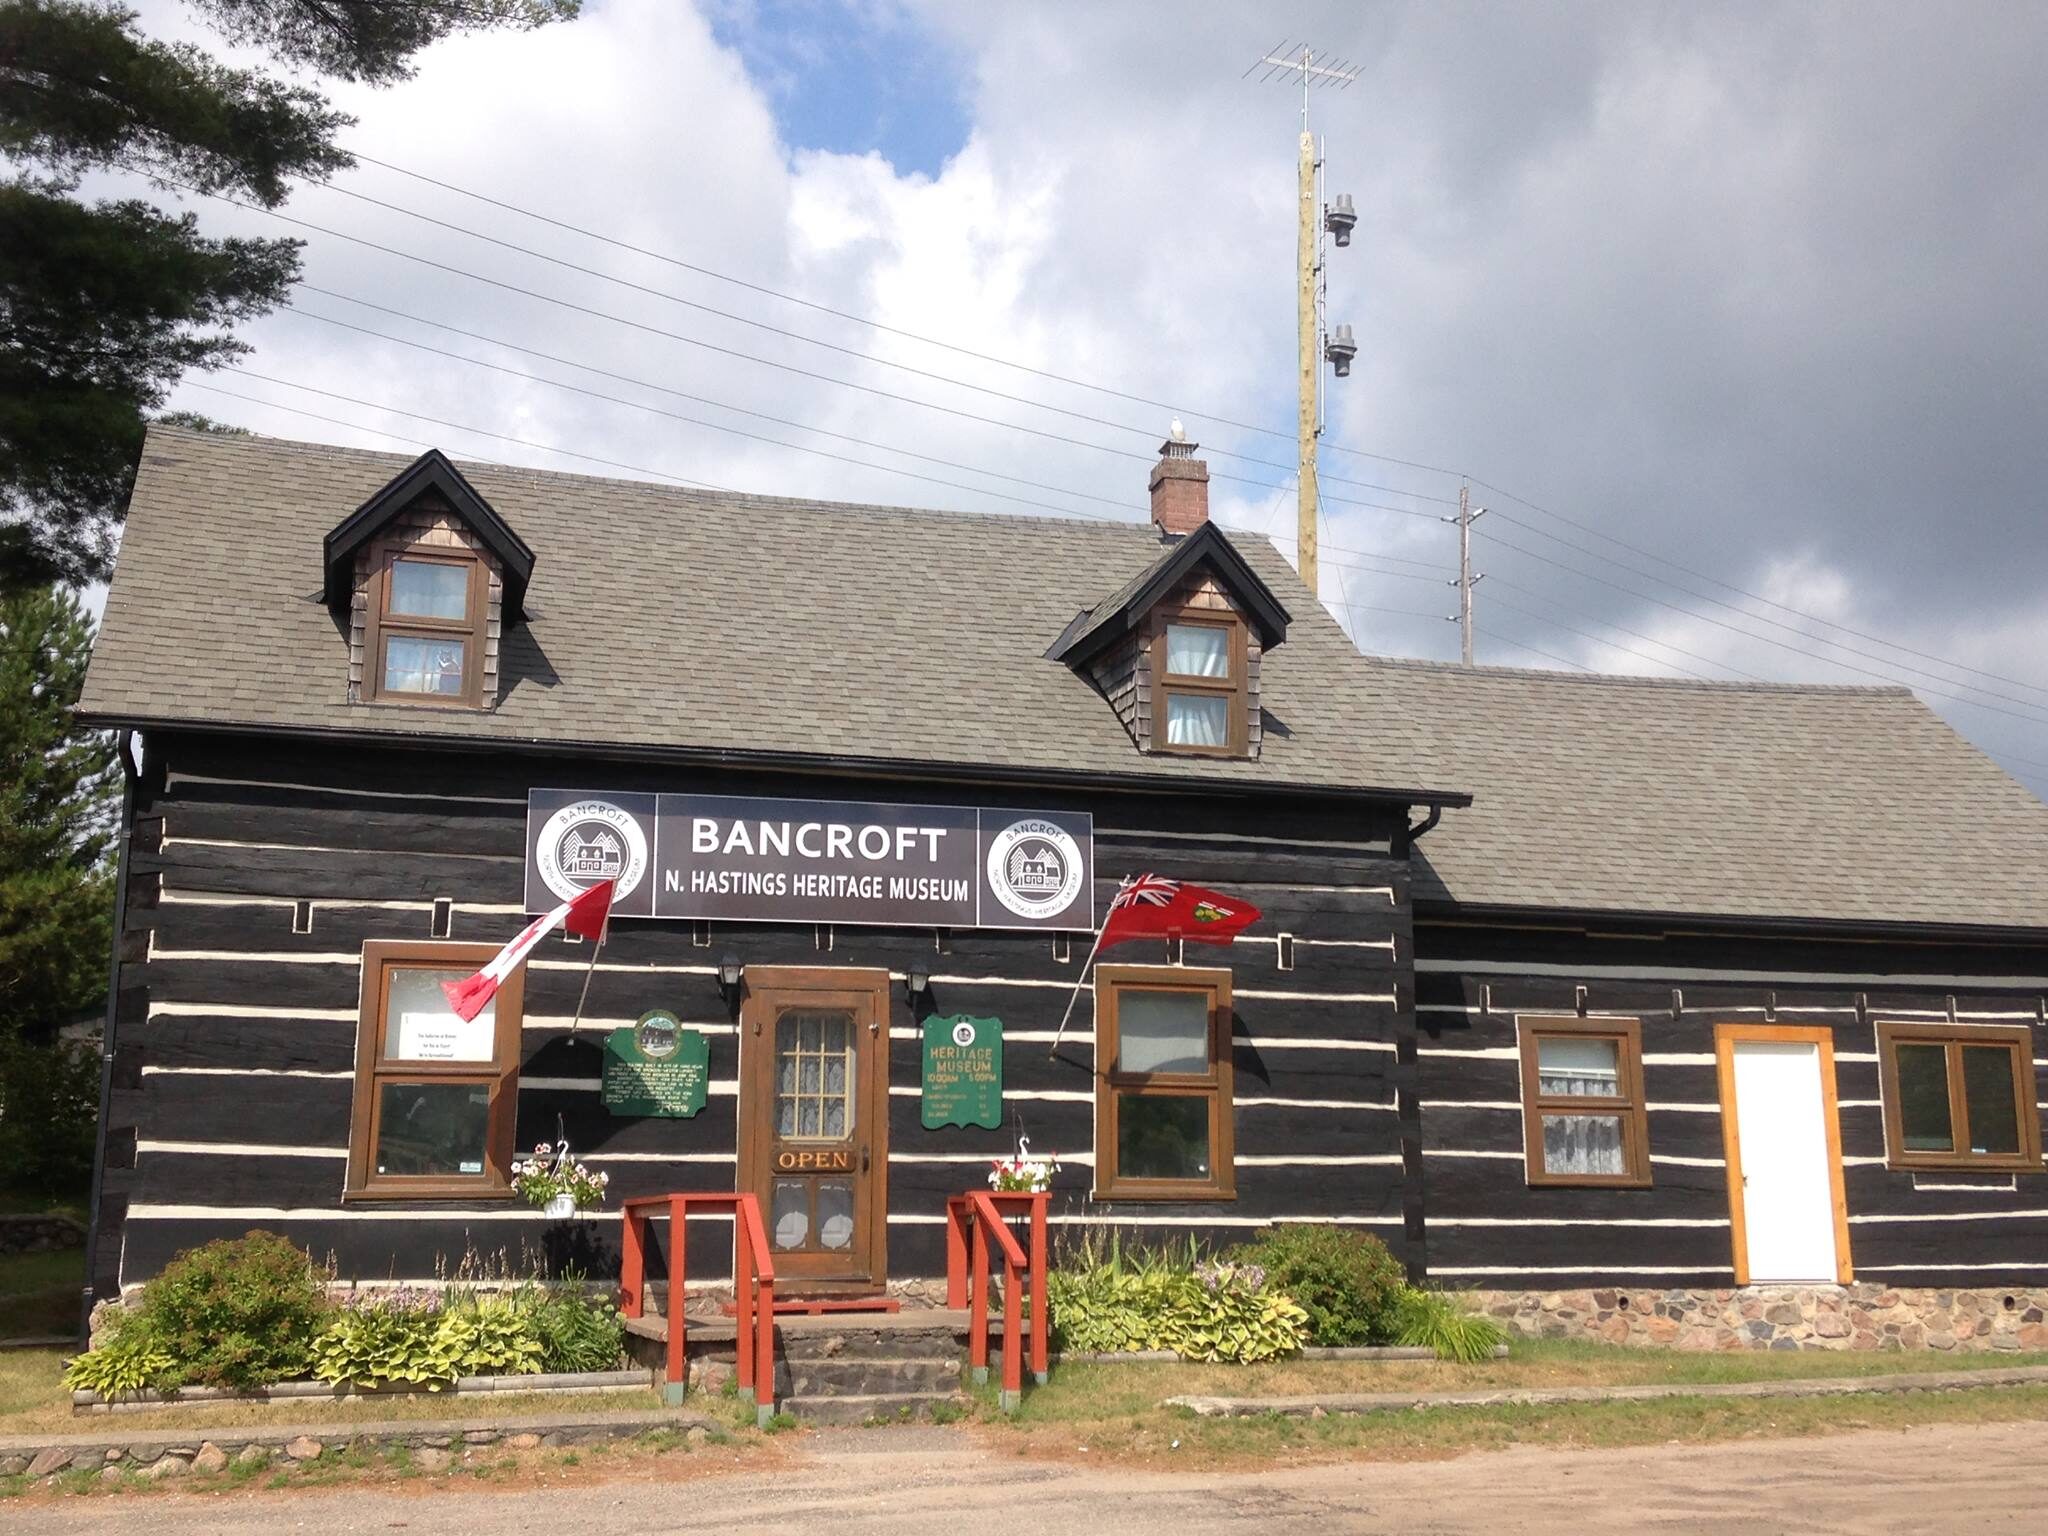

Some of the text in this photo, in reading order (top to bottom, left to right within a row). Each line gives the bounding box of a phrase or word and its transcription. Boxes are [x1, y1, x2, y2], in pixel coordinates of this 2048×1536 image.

[559, 804, 630, 827] BANCROFT
[692, 818, 948, 862] BANCROFT
[1005, 822, 1067, 842] BANCROFT
[665, 869, 968, 902] N. HASTINGS HERITAGE MUSEUM
[930, 1047, 992, 1060] HERITAGE
[936, 1061, 991, 1072] MUSEUM
[779, 1152, 848, 1169] OPEN
